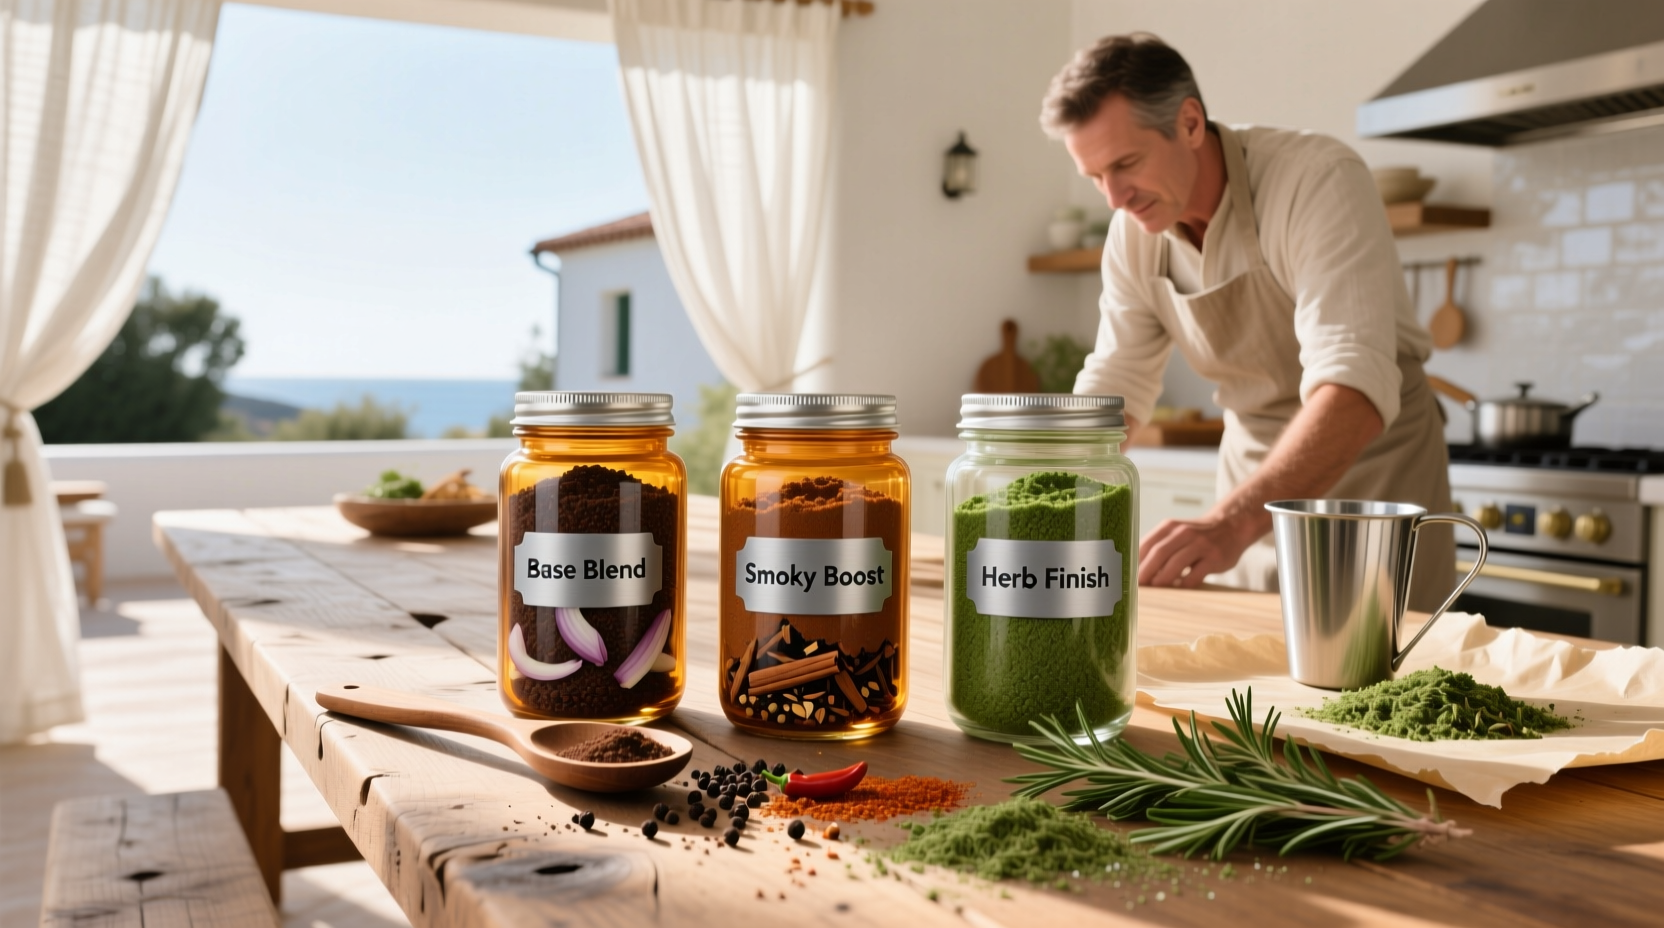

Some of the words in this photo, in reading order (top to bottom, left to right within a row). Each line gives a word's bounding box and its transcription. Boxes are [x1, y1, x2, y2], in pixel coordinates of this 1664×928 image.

[527, 558, 576, 580] Base
[583, 558, 646, 580] Blend
[745, 562, 817, 594] Smoky
[823, 564, 885, 587] Boost
[982, 565, 1038, 590] Herb
[1044, 565, 1110, 589] Finish
